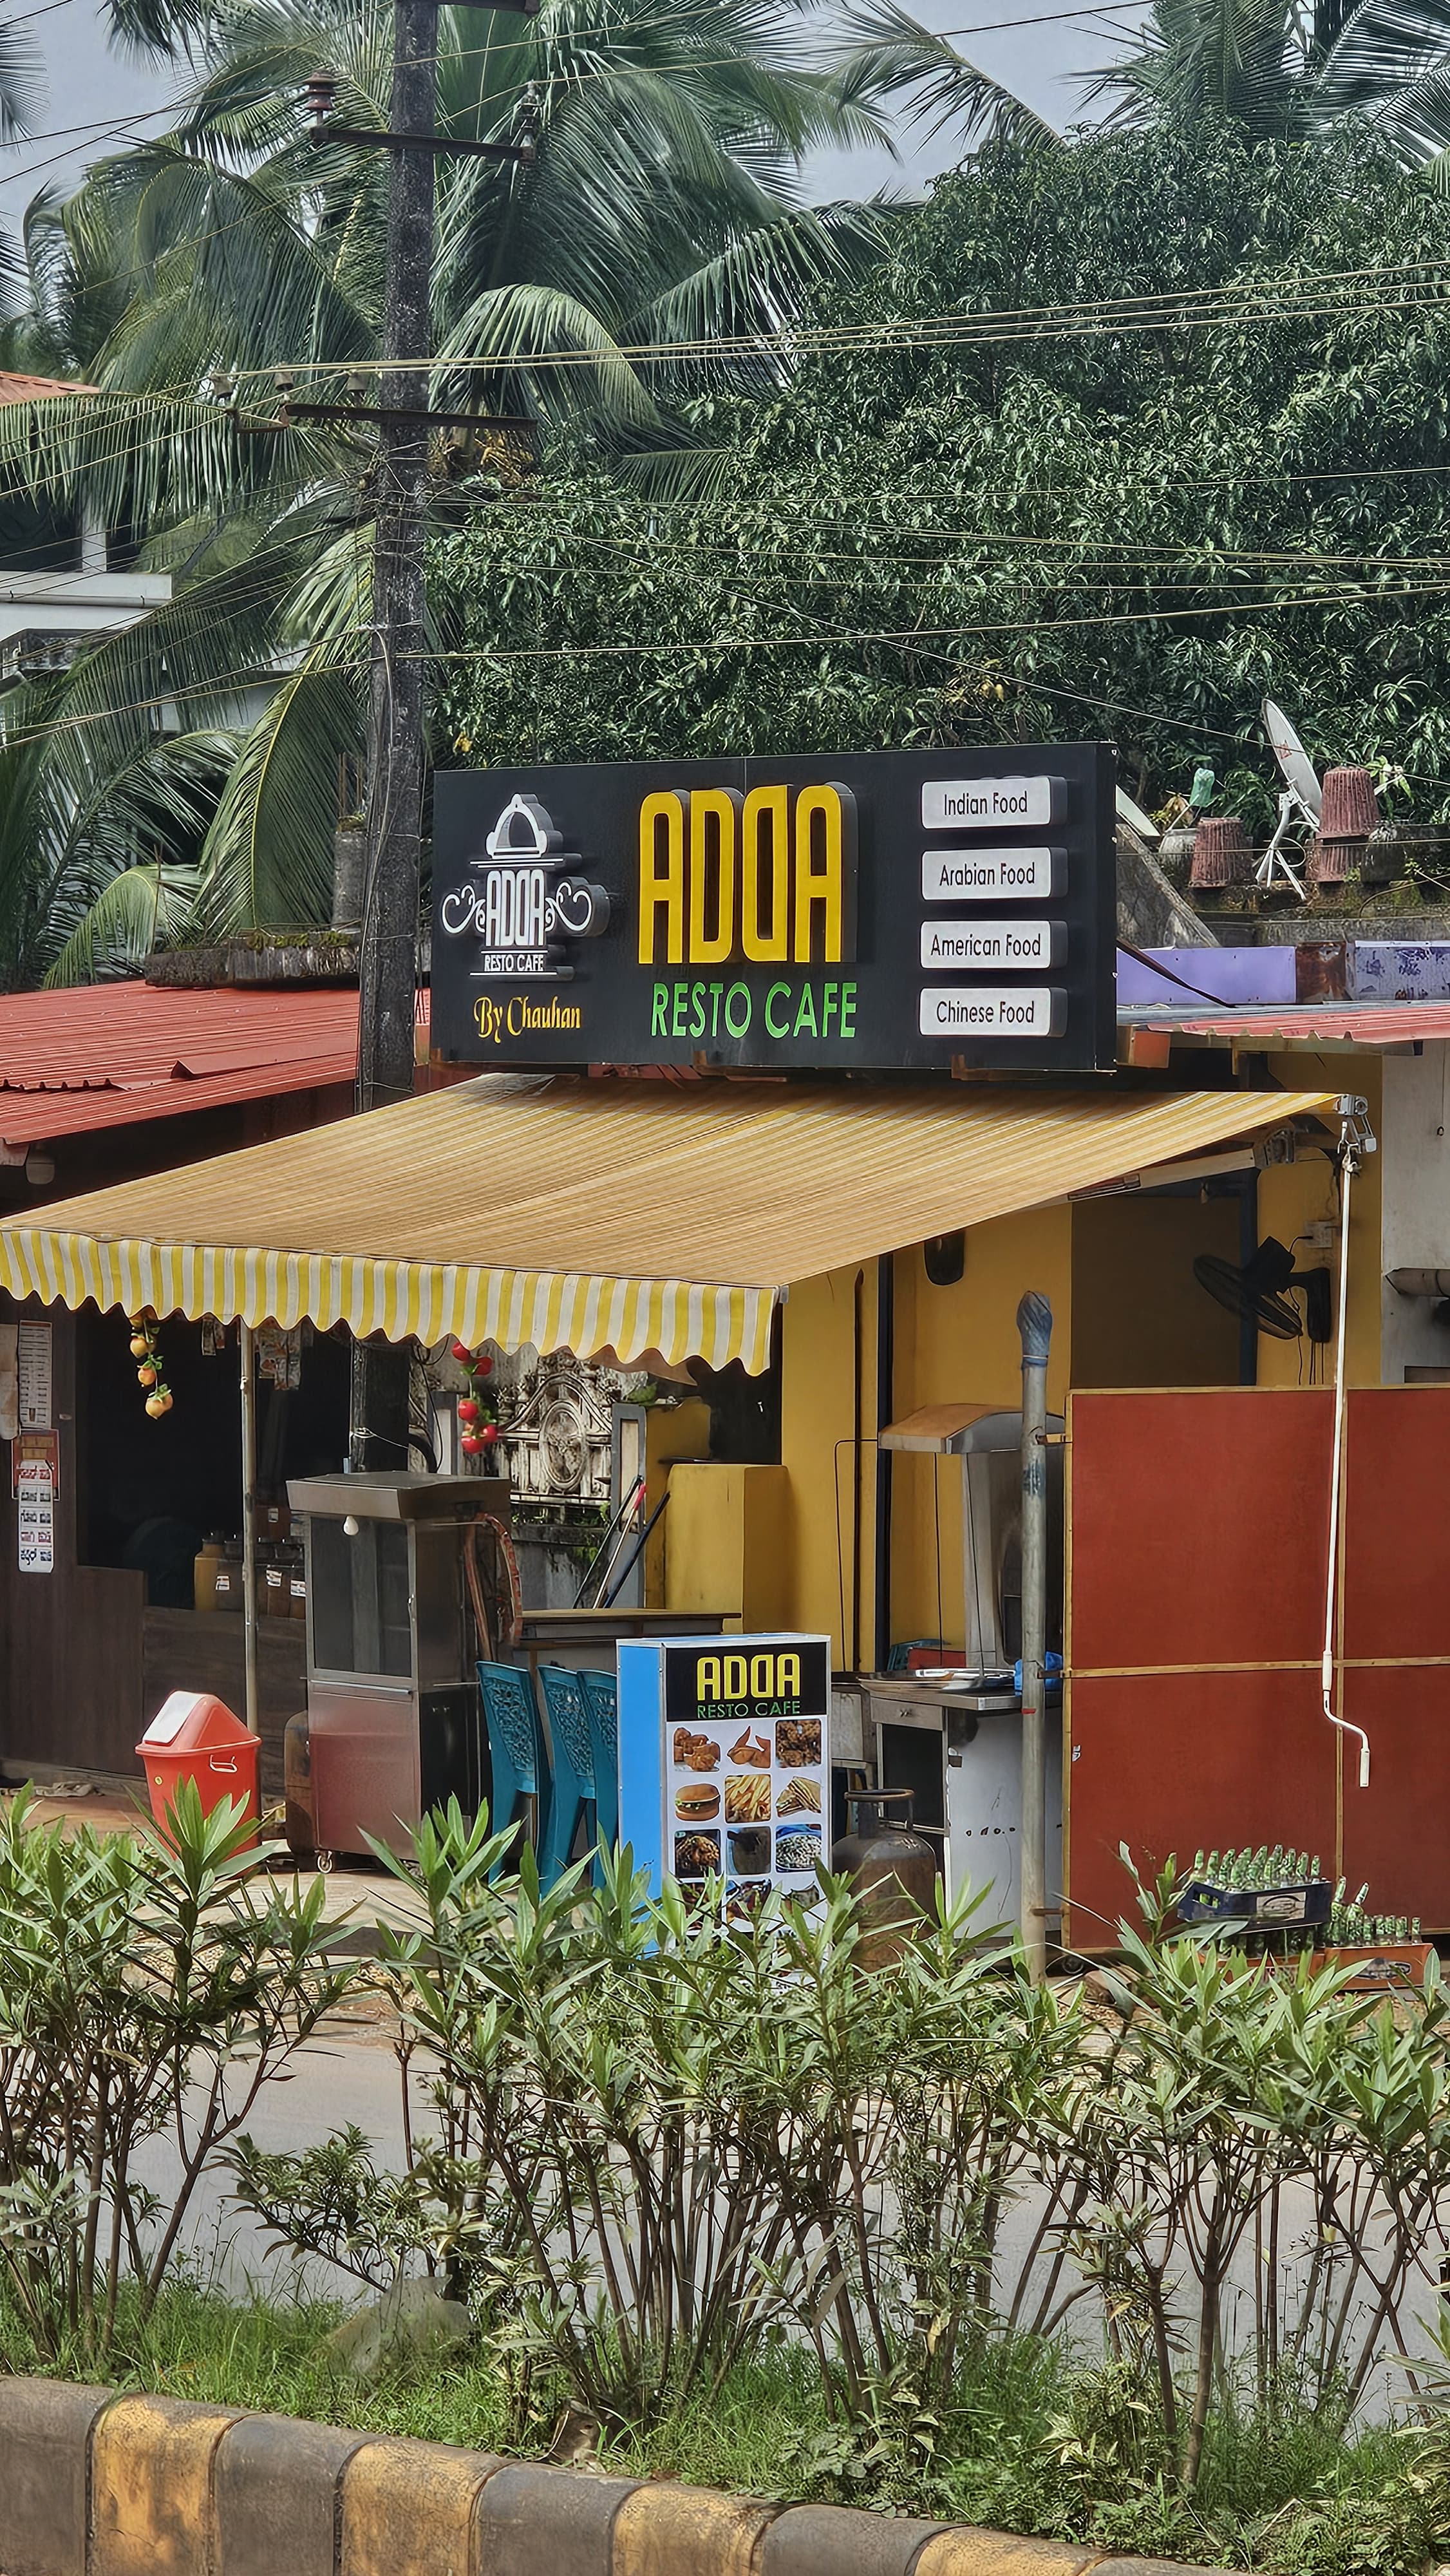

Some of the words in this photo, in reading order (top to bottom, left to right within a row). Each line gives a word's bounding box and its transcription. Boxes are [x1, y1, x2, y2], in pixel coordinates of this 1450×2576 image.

[943, 793, 988, 816] Indian
[993, 790, 1028, 815] Food
[939, 864, 995, 887] Arabian
[1001, 862, 1035, 885] Food
[930, 934, 1001, 956] American
[1006, 933, 1041, 956] Food
[484, 954, 514, 972] RESTO
[516, 954, 544, 972] CAFE
[473, 996, 504, 1043] By
[507, 996, 581, 1036] Chauhan
[651, 981, 753, 1038] RESTO
[764, 981, 858, 1038] CAFE
[936, 1001, 994, 1023] Chinese
[999, 999, 1034, 1023] Food
[697, 1703, 749, 1719] RESTO
[755, 1700, 801, 1716] CAFE
